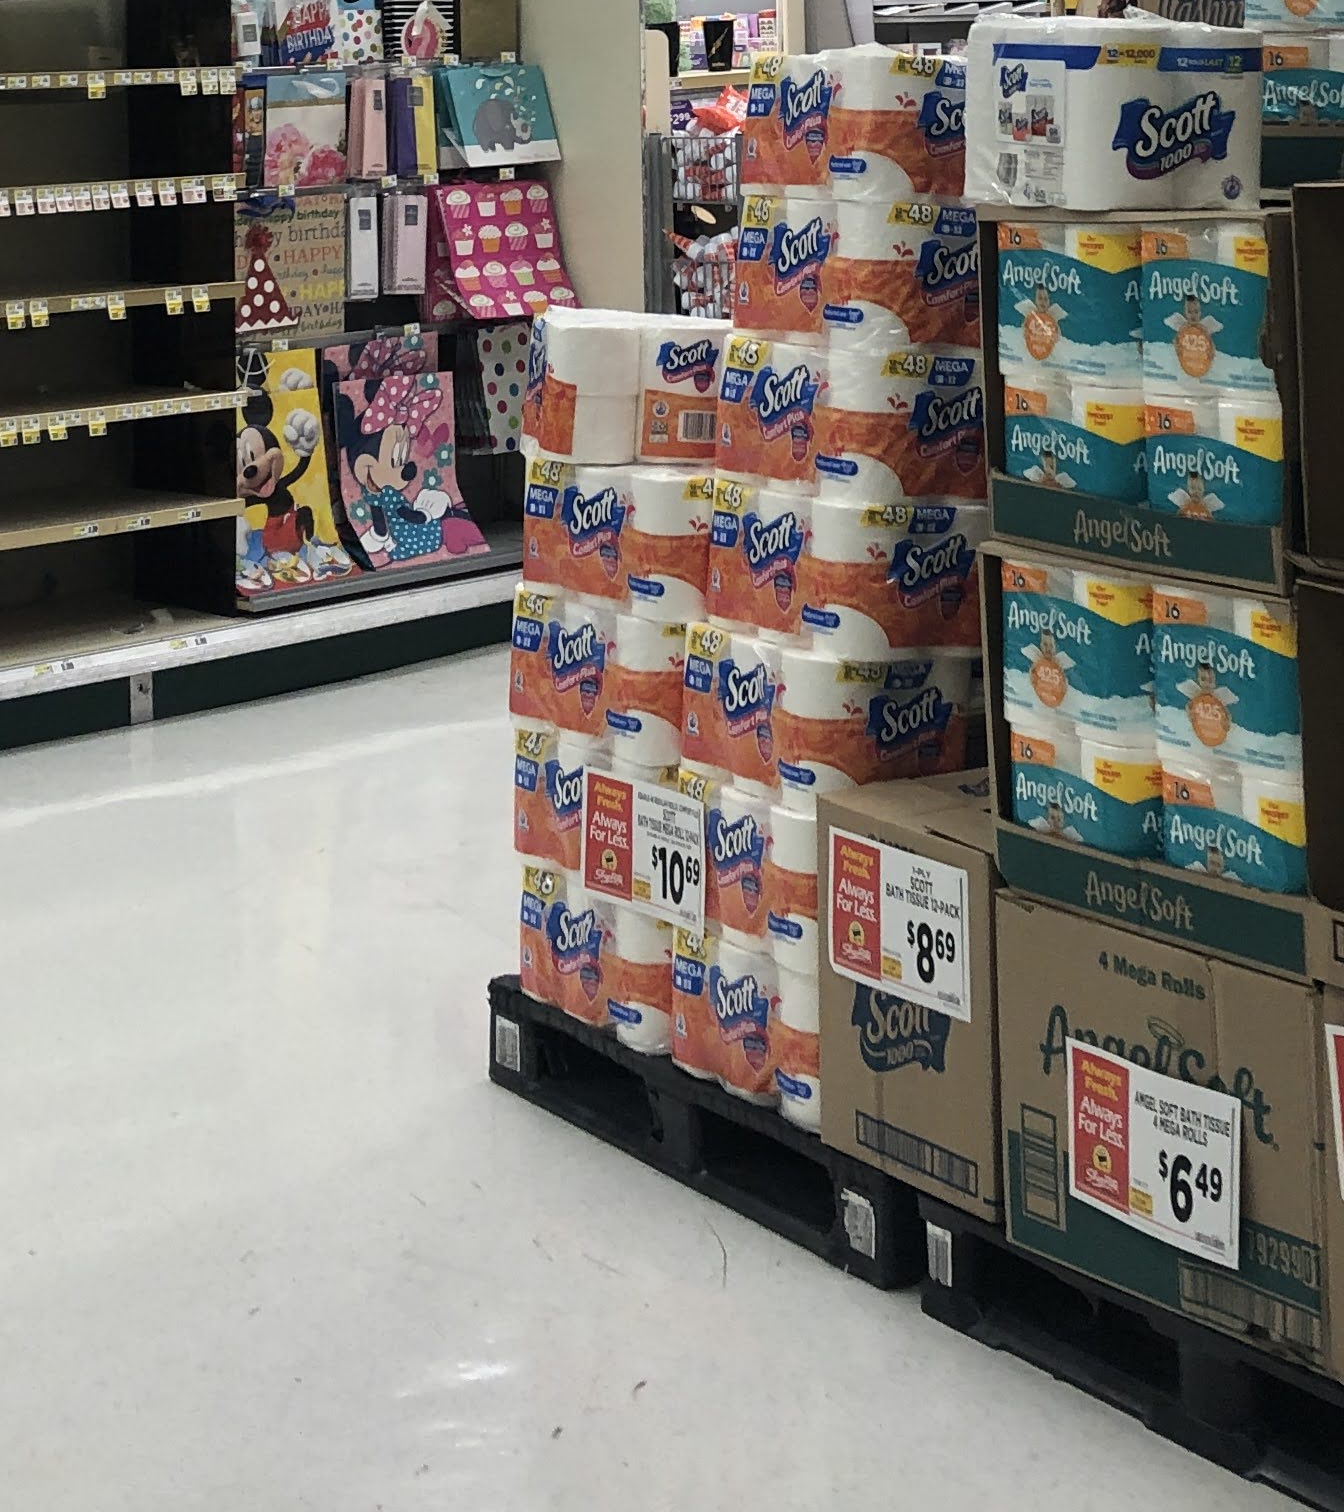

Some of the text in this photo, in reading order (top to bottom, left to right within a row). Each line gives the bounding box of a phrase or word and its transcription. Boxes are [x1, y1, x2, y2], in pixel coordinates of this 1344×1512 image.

[751, 87, 774, 100] MEGA
[785, 72, 824, 125] Scott
[1136, 91, 1216, 158] Scott
[1160, 144, 1191, 172] 1000
[908, 205, 975, 224] 48 MEGA
[669, 341, 709, 368] Scott
[760, 368, 809, 418] Scott
[530, 490, 554, 503] MEGA
[572, 490, 614, 535] Scott
[590, 825, 605, 841] For
[592, 811, 627, 833] Always
[838, 878, 874, 905] Always
[885, 883, 960, 919] BATH TISSUE 12-PACK
[910, 877, 933, 895] SCOTT
[836, 893, 877, 923] For Less.
[1099, 952, 1205, 1000] 4 Mega Rolls
[1079, 1095, 1123, 1129] Always
[1134, 1090, 1230, 1137] ANGEL SOFT BATH TISSUE
[1078, 1113, 1125, 1150] For Less.
[1157, 1116, 1180, 1139] MEGA
[1182, 1125, 1208, 1147] ROLLS
